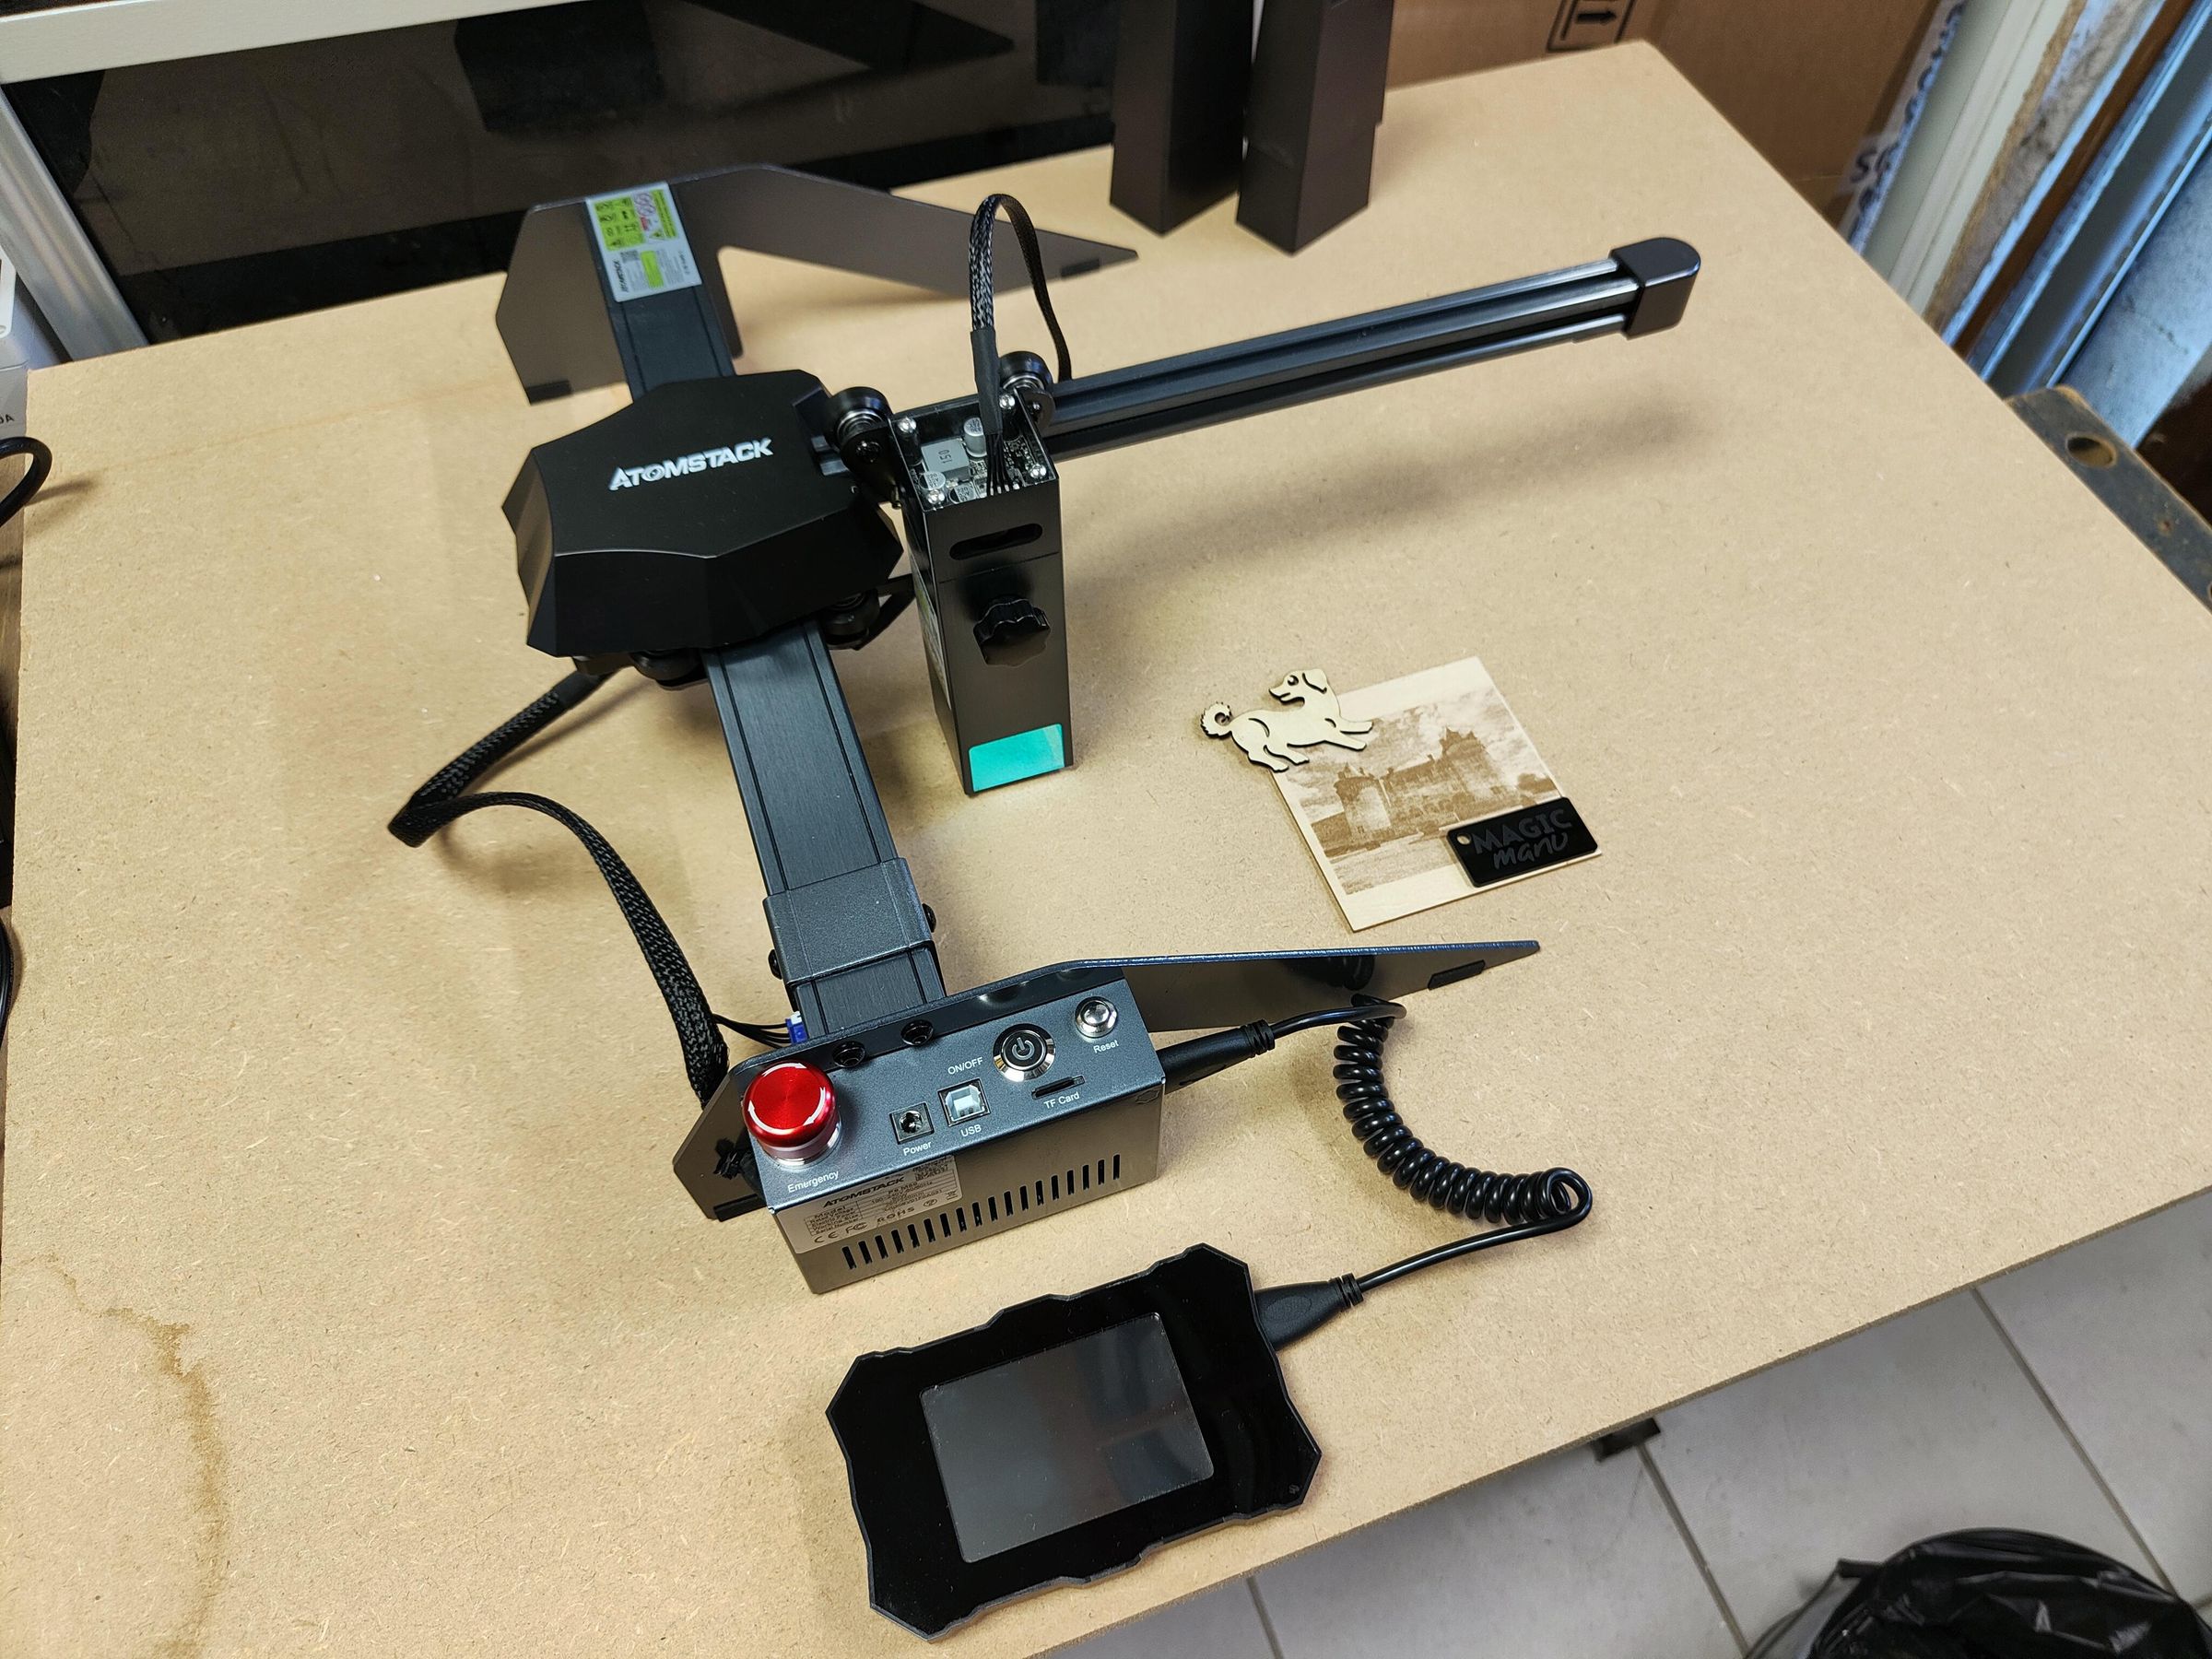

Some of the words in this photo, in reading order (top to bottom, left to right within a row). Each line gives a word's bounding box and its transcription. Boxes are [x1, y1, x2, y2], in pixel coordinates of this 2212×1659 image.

[608, 437, 773, 491] ATOMSTACK
[1472, 809, 1571, 853] MAGIC
[1493, 832, 1569, 869] manu
[1093, 1039, 1120, 1053] Reset
[947, 1056, 983, 1076] ON/OFF
[1043, 1099, 1057, 1110] TF
[1058, 1090, 1080, 1106] Card
[960, 1124, 982, 1138] USB
[902, 1141, 932, 1157] Power
[787, 1171, 839, 1193] Emergency
